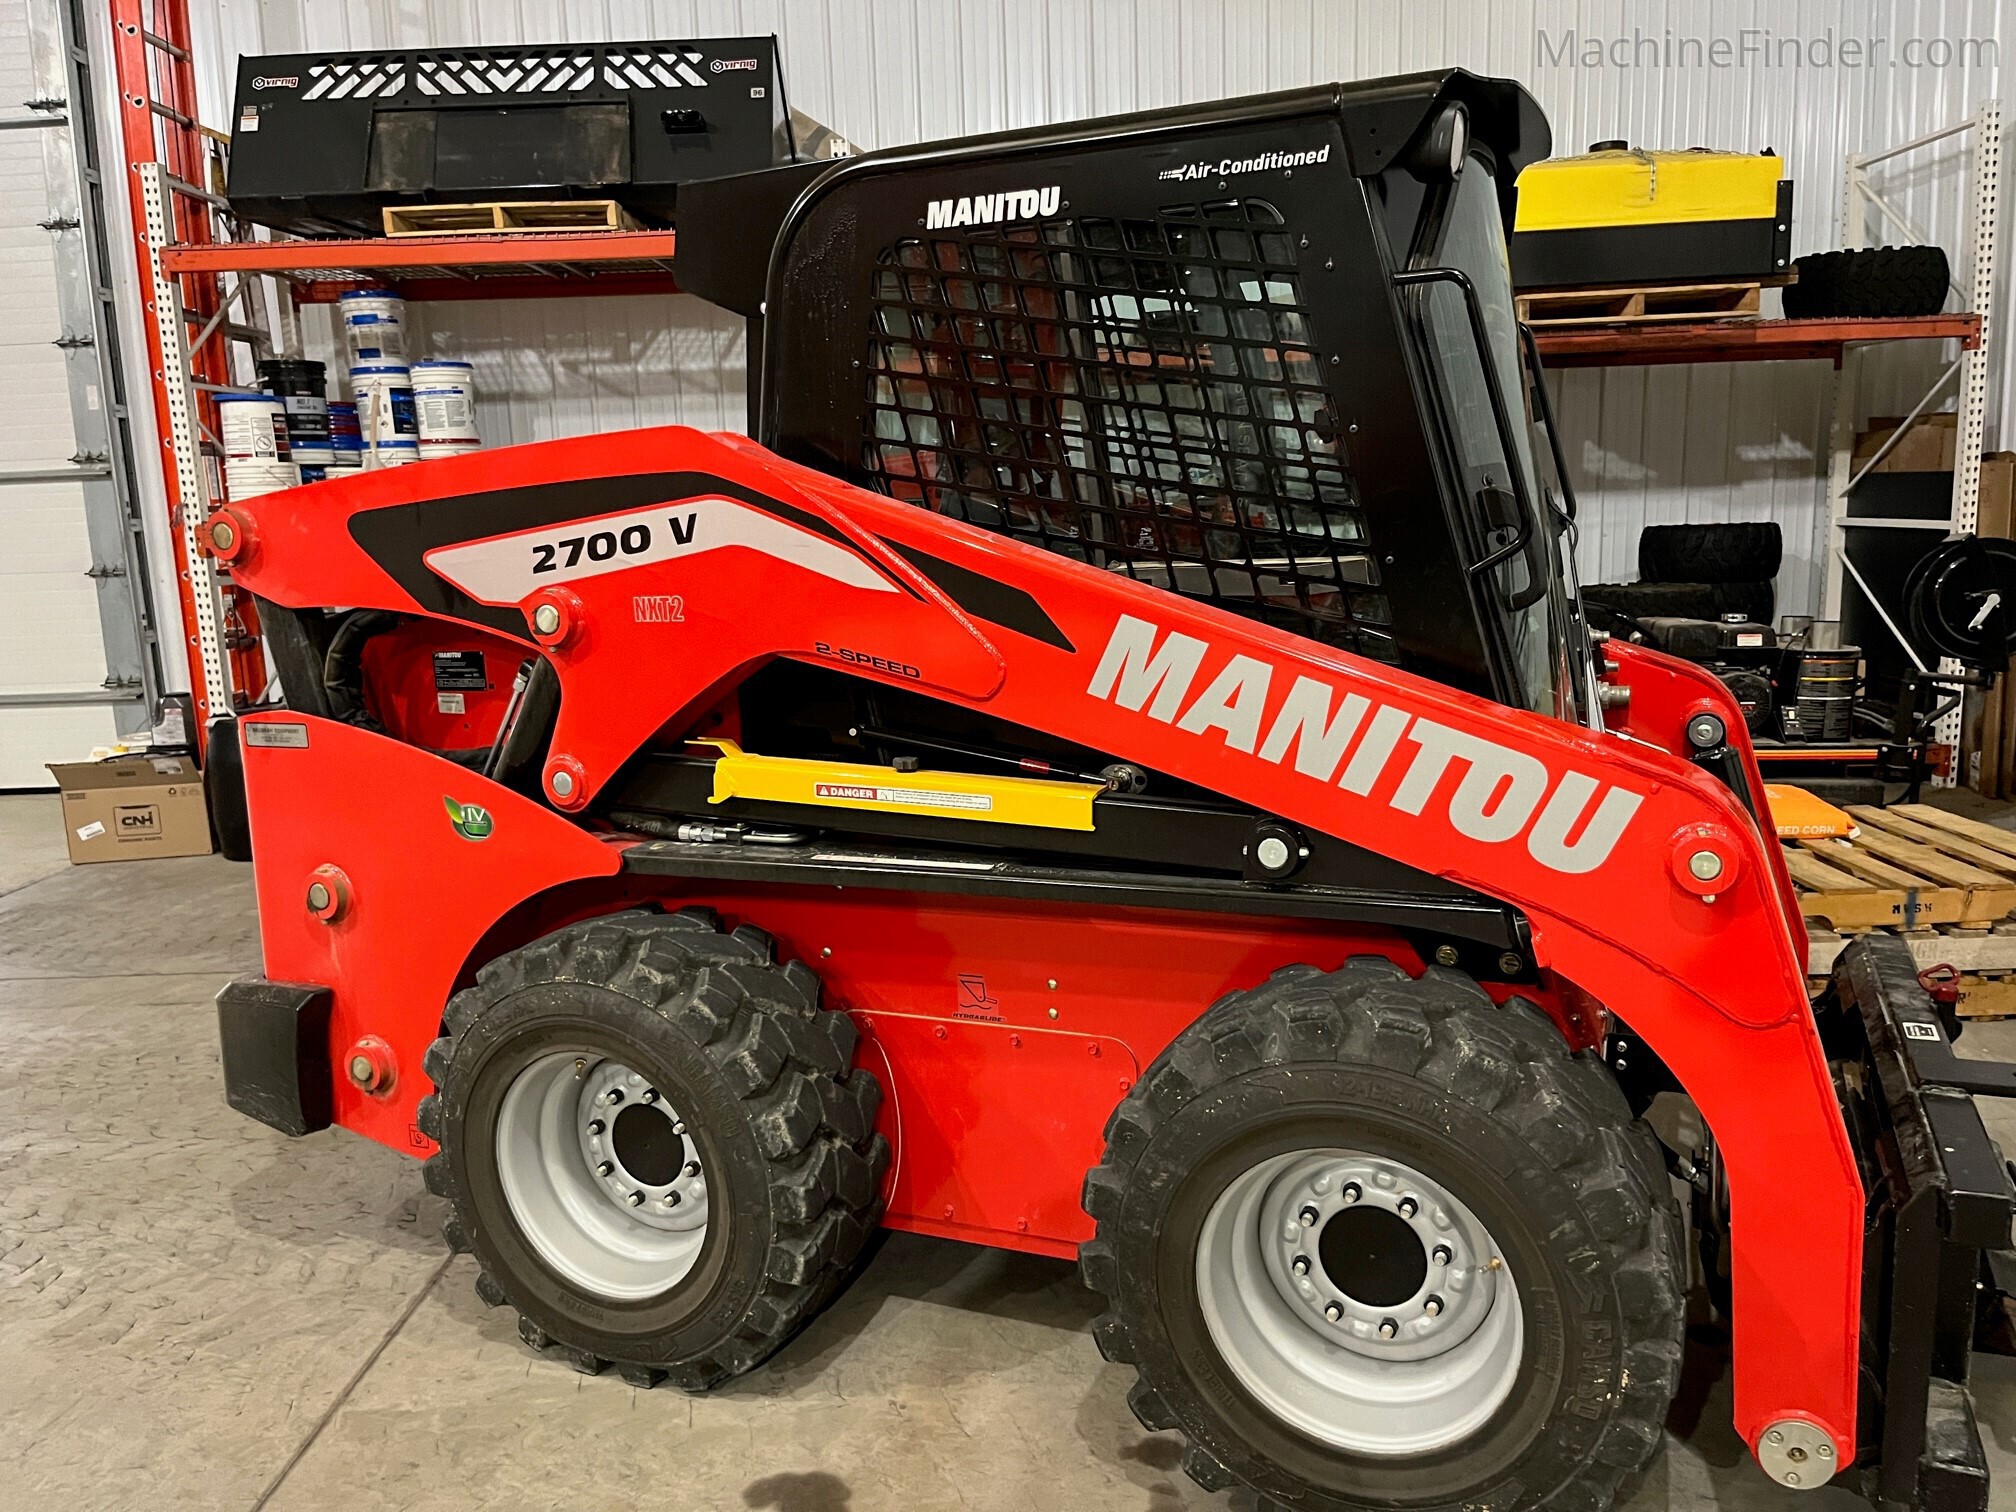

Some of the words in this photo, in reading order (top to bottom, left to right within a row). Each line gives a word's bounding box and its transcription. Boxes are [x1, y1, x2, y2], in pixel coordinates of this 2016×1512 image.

[1185, 145, 1331, 181] Air-Conditioned
[926, 186, 1061, 230] MANITOU
[532, 524, 651, 575] 2700
[668, 512, 698, 545] V
[633, 595, 684, 623] NXT2
[815, 641, 921, 679] 2-SPEED
[1086, 613, 1645, 874] MANITOU
[830, 786, 874, 799] DANGER
[121, 811, 154, 826] CNH
[1777, 825, 1800, 835] EED
[1802, 824, 1835, 835] CORN
